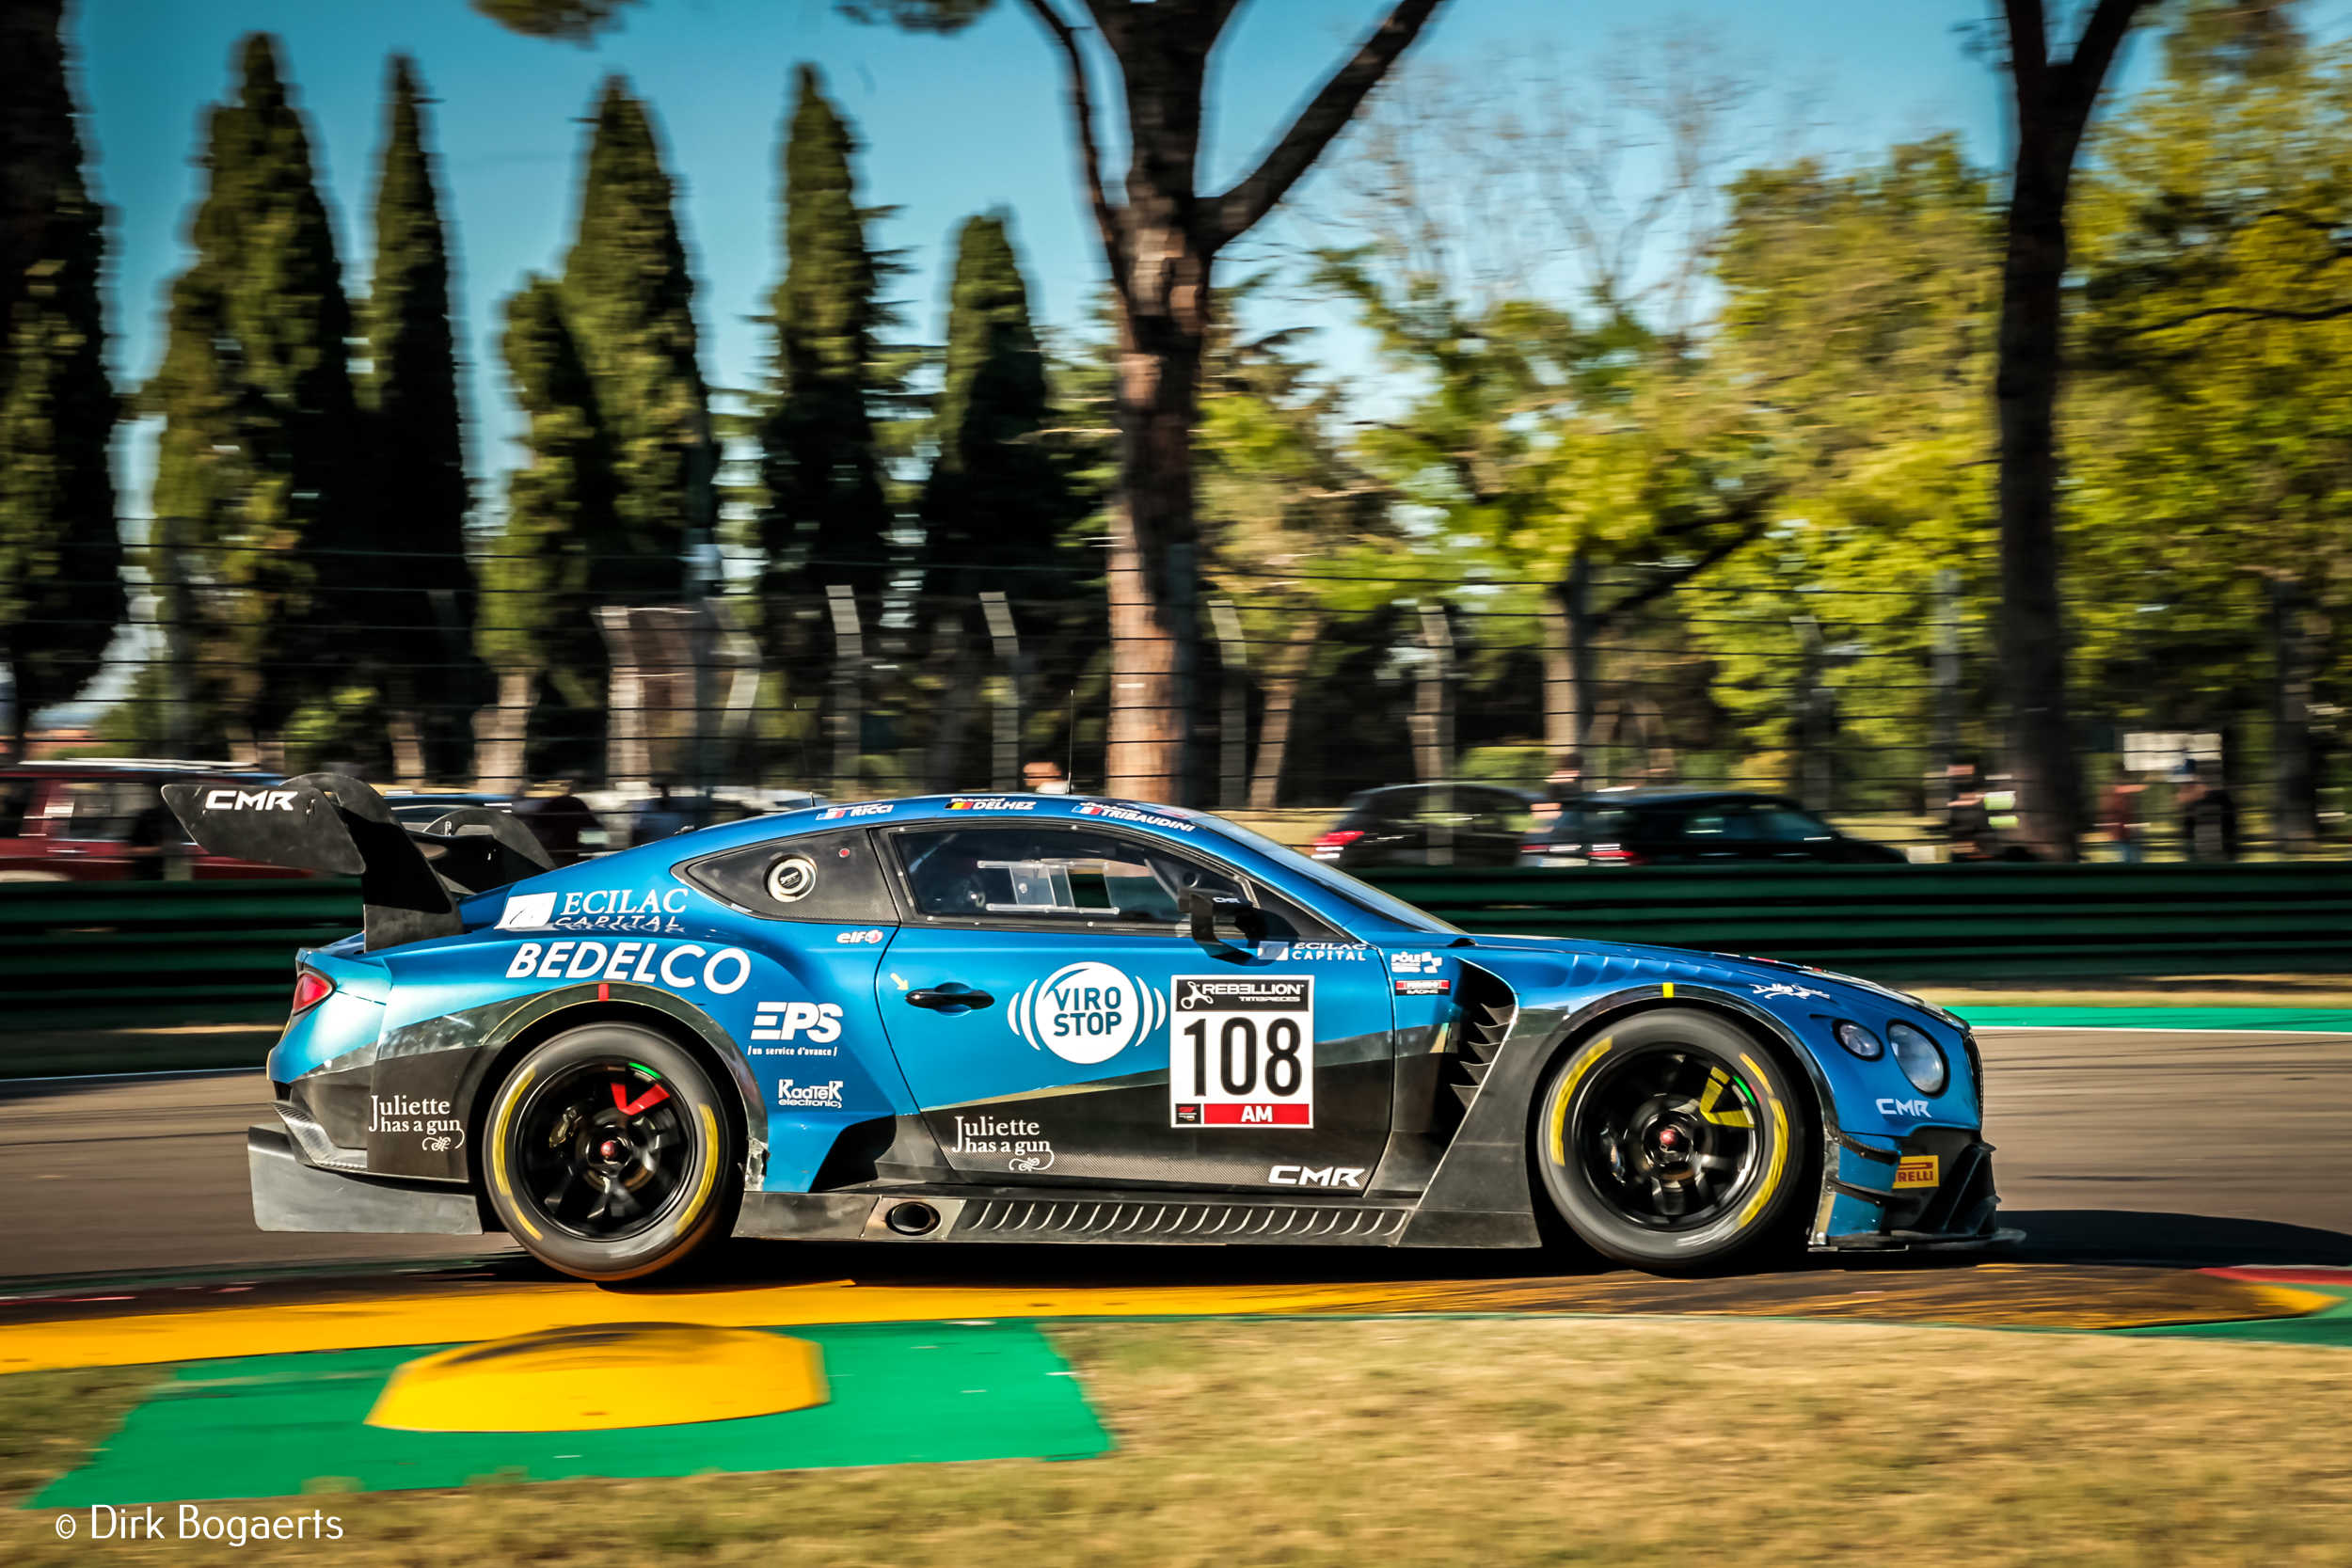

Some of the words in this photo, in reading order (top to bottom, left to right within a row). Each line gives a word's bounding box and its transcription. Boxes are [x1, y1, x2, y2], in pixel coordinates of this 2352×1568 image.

[204, 790, 298, 811] CMR
[850, 804, 895, 816] RICCI
[972, 801, 1037, 810] DELHEZ
[1101, 809, 1196, 832] TRIBAUDINI
[560, 888, 689, 915] ECILAC
[555, 915, 680, 927] CAPITAL
[1292, 950, 1367, 961] CAPITAL
[1294, 942, 1368, 950] ECILAC
[505, 942, 752, 994] BEDELCO
[1054, 986, 1121, 1011] VIRO
[1202, 984, 1301, 995] REBELLION
[751, 1002, 844, 1043] EPS
[1054, 1011, 1122, 1037] STOP
[765, 1047, 795, 1055] service
[1184, 1017, 1303, 1097] 108
[369, 1095, 451, 1132] Juliette
[1241, 1105, 1273, 1122] AM
[1875, 1098, 1932, 1118] CMR
[380, 1117, 410, 1132] has
[413, 1119, 423, 1132] a
[426, 1119, 464, 1136] gun
[951, 1116, 1041, 1153] Juliette
[964, 1137, 997, 1153] has
[1000, 1141, 1011, 1153] a
[1014, 1140, 1052, 1156] gun
[1268, 1165, 1365, 1187] CMR
